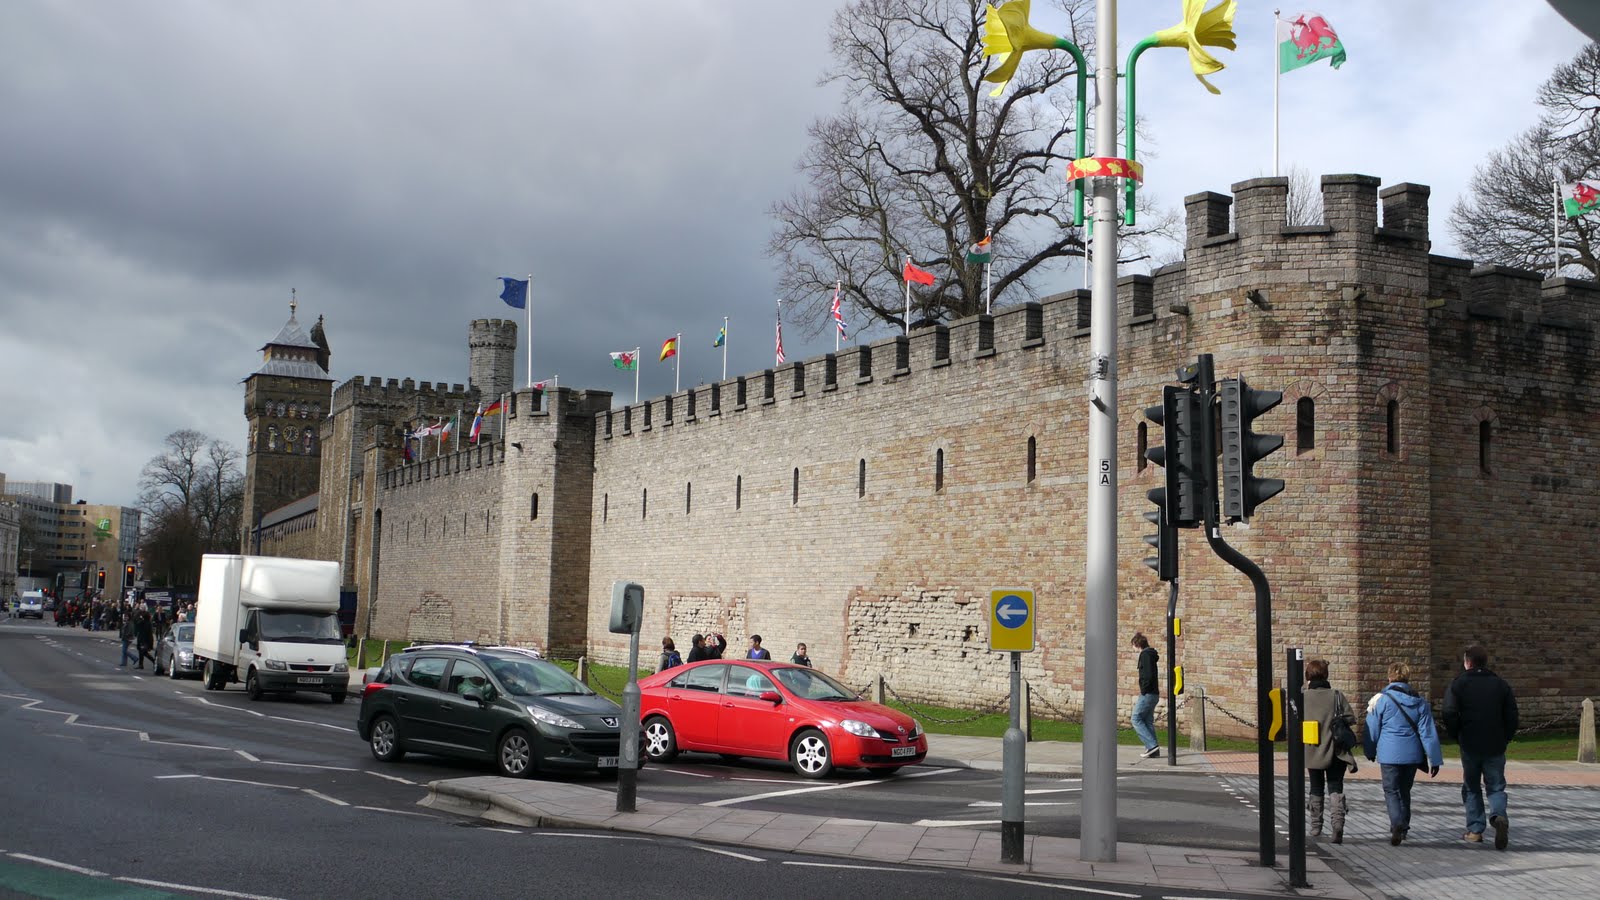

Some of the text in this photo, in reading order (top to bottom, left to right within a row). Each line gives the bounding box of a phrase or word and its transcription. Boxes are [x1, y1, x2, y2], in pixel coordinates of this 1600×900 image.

[1101, 460, 1109, 471] 5
[1101, 473, 1110, 485] A
[1012, 660, 1018, 672] 1
